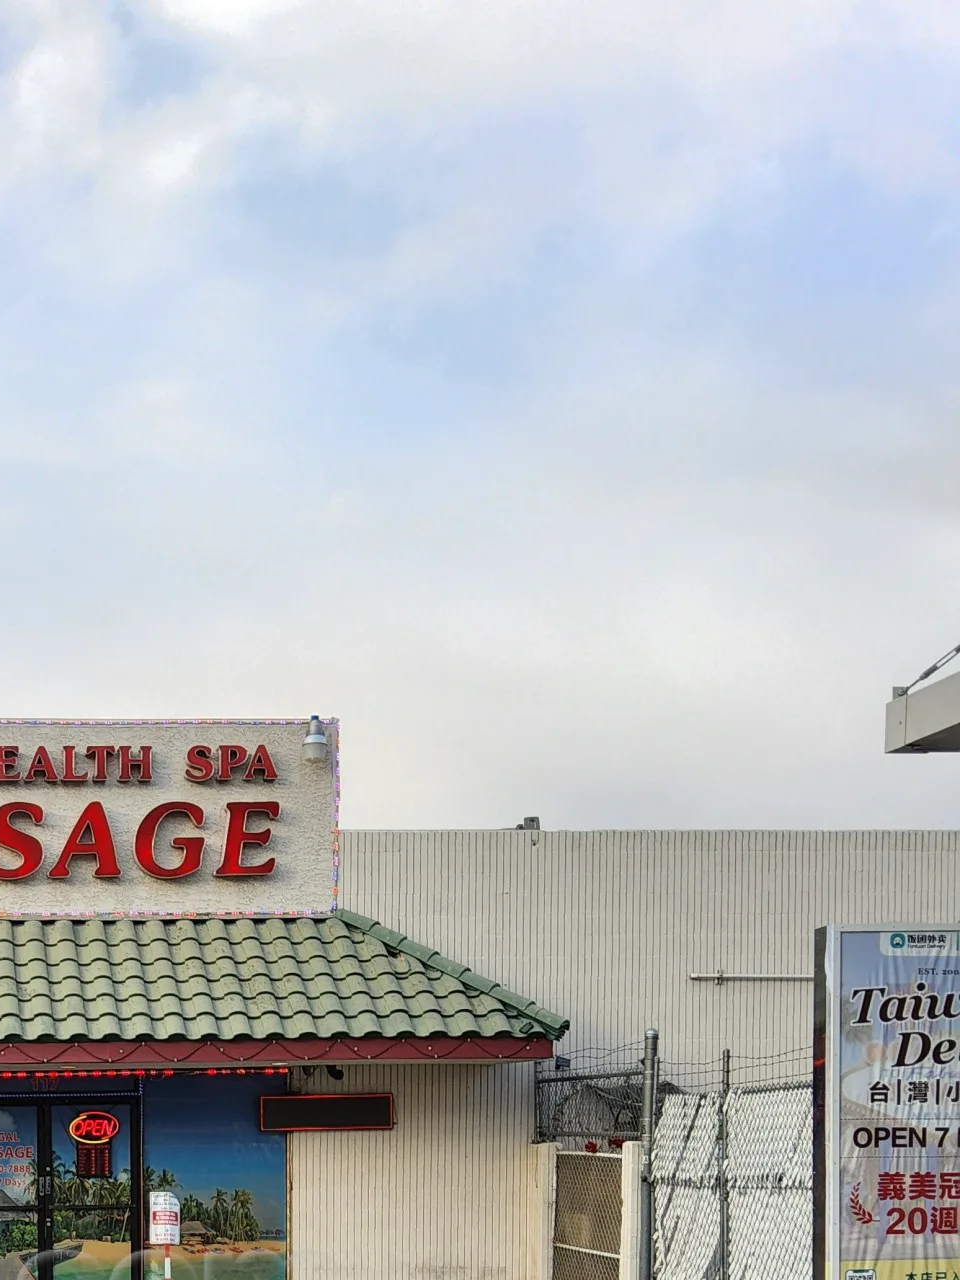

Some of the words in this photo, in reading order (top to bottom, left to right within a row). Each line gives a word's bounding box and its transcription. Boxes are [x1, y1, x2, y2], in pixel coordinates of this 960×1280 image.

[185, 744, 278, 782] SPA
[907, 934, 947, 944] 饭团外卖
[918, 967, 938, 976] EST.
[891, 1031, 960, 1068] De
[71, 1119, 115, 1136] OPEN
[853, 1127, 927, 1149] OPEN
[935, 1127, 950, 1148] 7
[4, 1178, 27, 1188] Days
[886, 1206, 959, 1235] 20週
